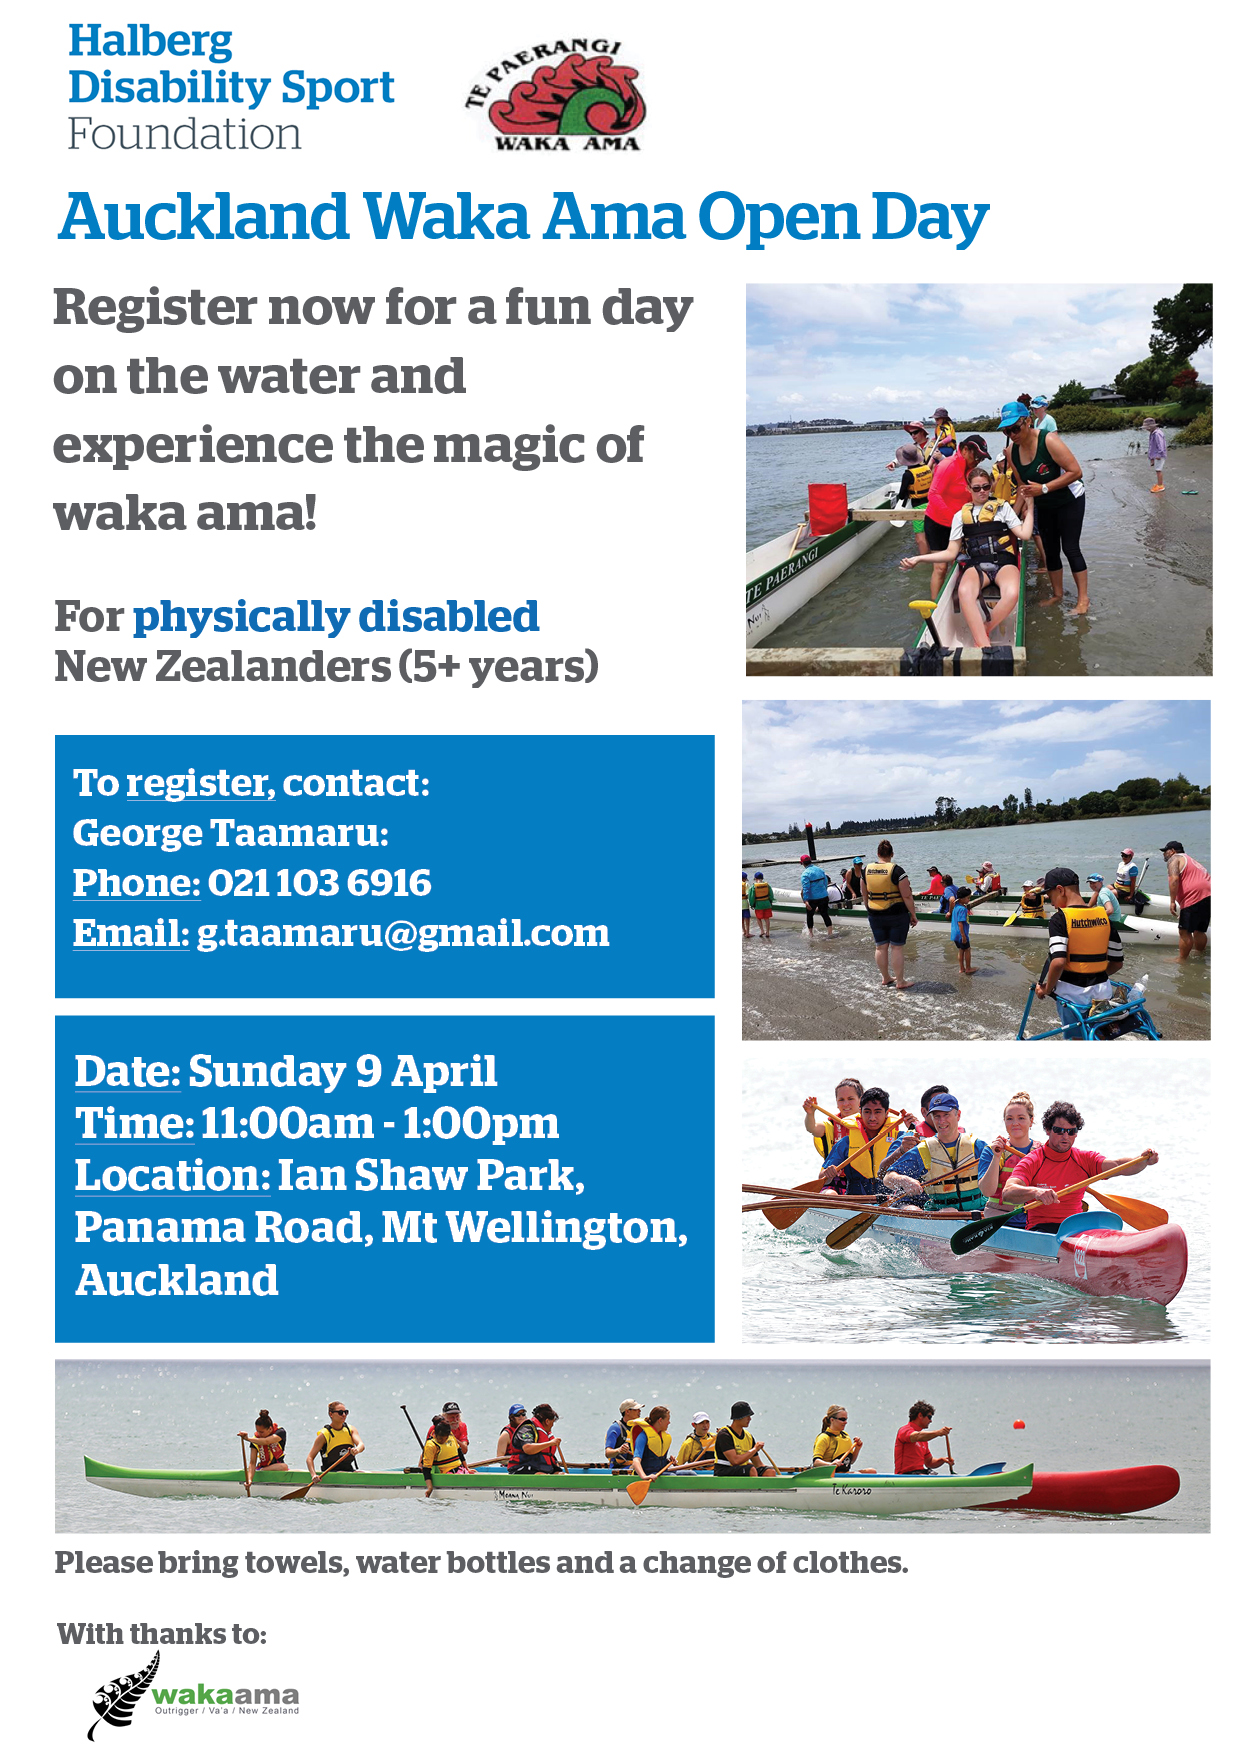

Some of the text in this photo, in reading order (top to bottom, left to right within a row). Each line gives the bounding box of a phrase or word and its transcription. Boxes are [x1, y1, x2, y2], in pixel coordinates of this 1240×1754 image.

[69, 24, 232, 64] Halberg
[69, 69, 395, 110] Disability Sport
[465, 38, 623, 109] TE PAERANGI
[68, 117, 302, 149] Foundation
[495, 137, 641, 151] WAKA AMA
[57, 191, 990, 250] Auckland Waka Ama Open Day
[54, 286, 694, 333] Register now for a fun day
[54, 357, 466, 394] on the water and
[53, 424, 644, 471] experience the magic of
[53, 494, 316, 530] waka ama!
[746, 547, 818, 604] TE PAERANGI
[55, 599, 540, 638] For physically disabled
[55, 648, 598, 688] New Zealanders (5+ years)
[73, 768, 429, 802] To register, contact:
[73, 819, 388, 852] George Taamaru:
[73, 869, 432, 896] Phone: 021 103 6916
[73, 918, 610, 952] Email: g.taamaru@gmail.com
[1071, 918, 1107, 928] Hutchwilco
[75, 1054, 498, 1093] Date: Sunday 9 April
[75, 1106, 195, 1145] Time:
[202, 1106, 374, 1139] 11:00am
[404, 1106, 559, 1145] 1:00pm
[75, 1158, 584, 1197] Location: Ian Shaw Park,
[75, 1210, 687, 1250] Panama Road, Mt Wellington,
[75, 1264, 279, 1296] Auckland
[832, 1483, 872, 1495] Te Karoro
[55, 1550, 908, 1578] Please bring towels, water bottles and a change of clothes.
[57, 1623, 266, 1644] With thanks to:
[151, 1683, 299, 1704] wakaama
[155, 1707, 198, 1716] Outrigger
